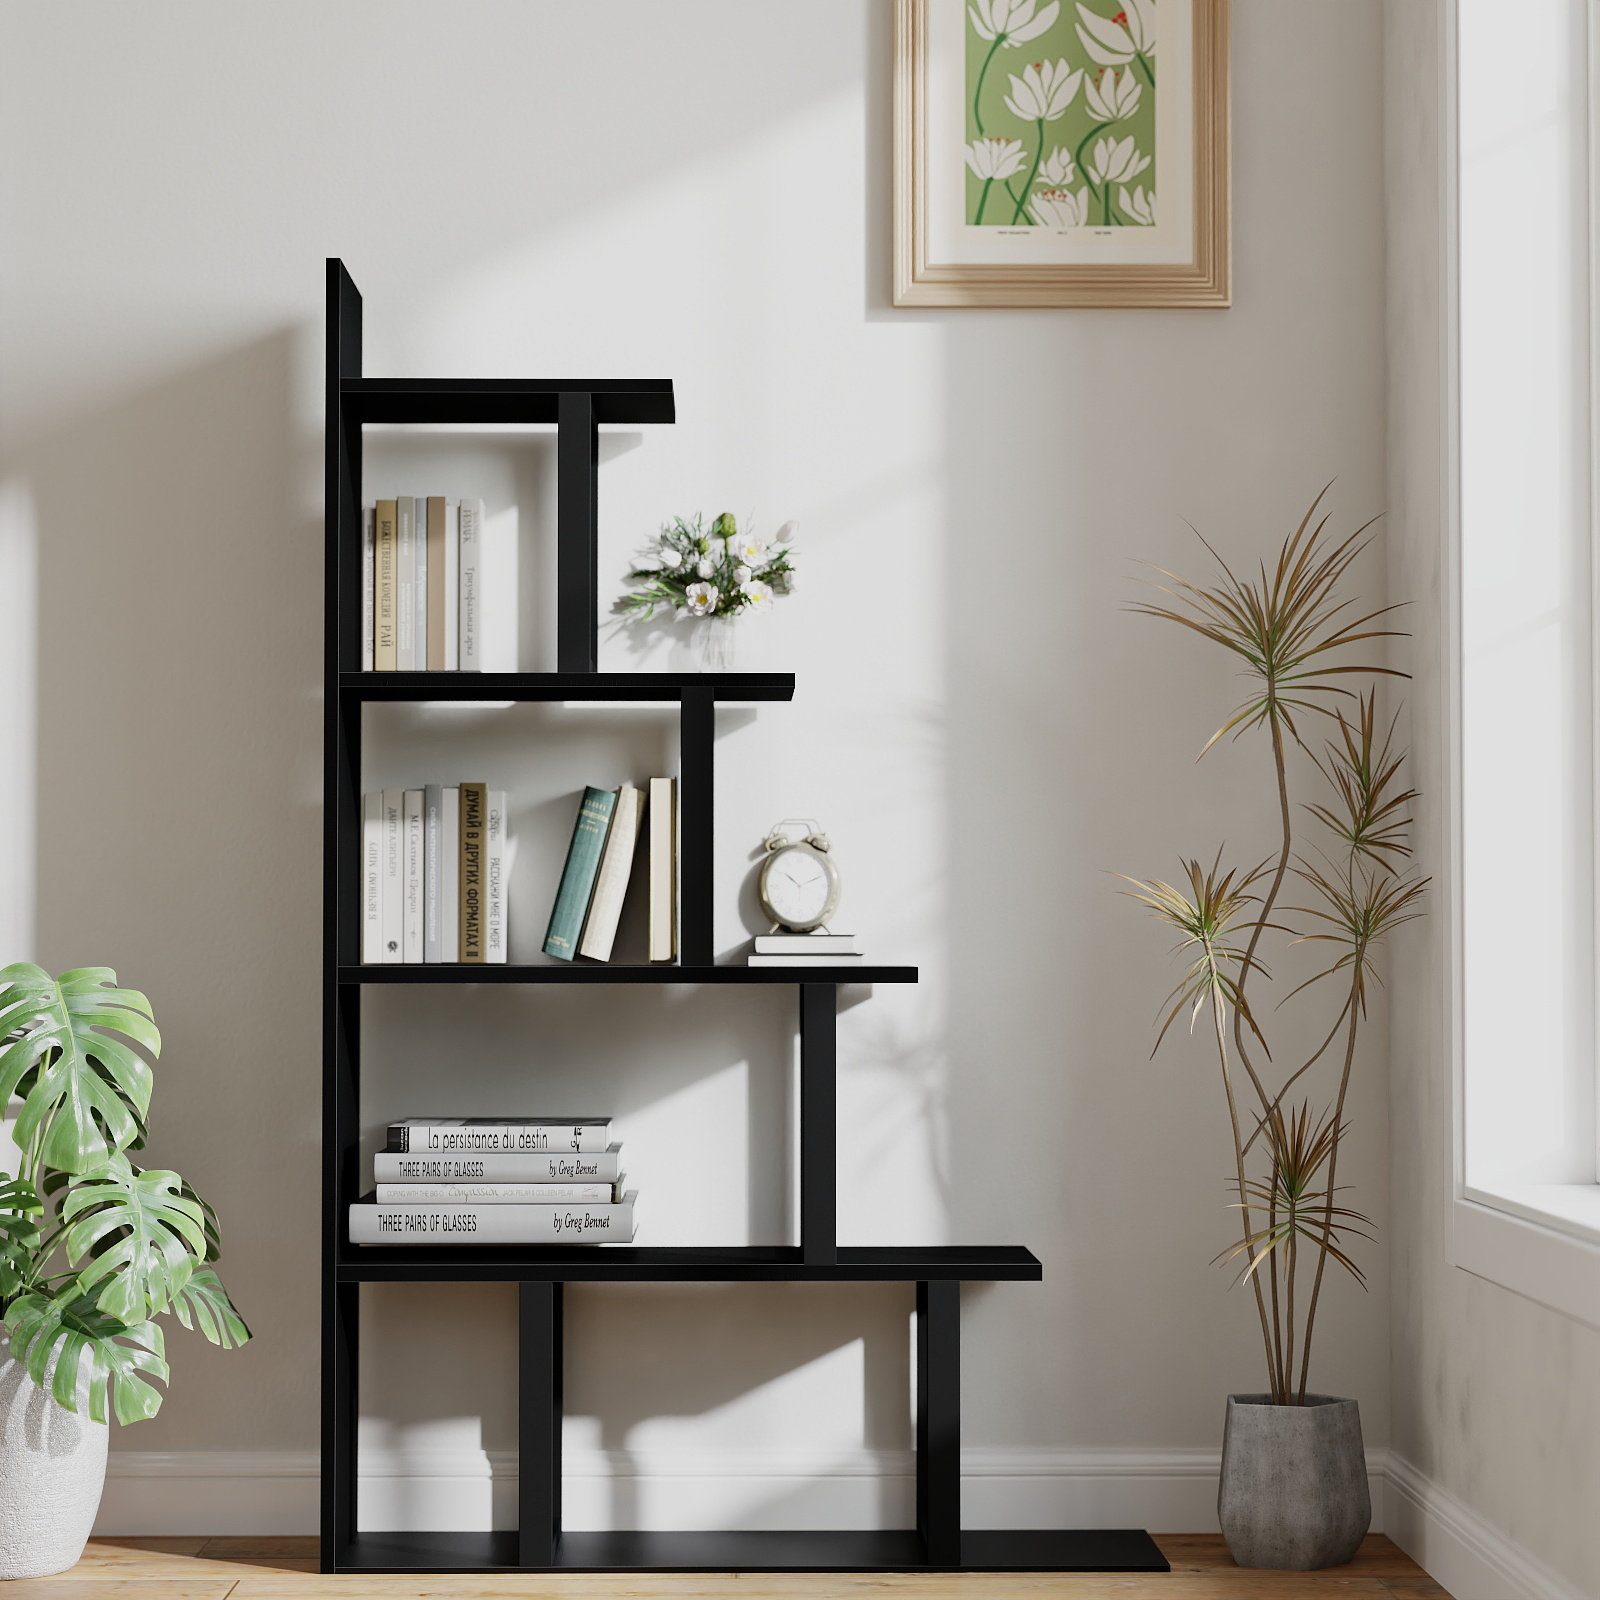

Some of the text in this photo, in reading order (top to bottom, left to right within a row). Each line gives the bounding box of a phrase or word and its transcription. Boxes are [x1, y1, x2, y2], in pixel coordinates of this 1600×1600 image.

[463, 509, 472, 544] РЕМАРК
[381, 521, 394, 647] БОЖЕСТВЕННАЯ КОМЕДИЯ РАЙ
[464, 566, 476, 656] Триумфальная арка
[465, 789, 482, 828] ДУМАЙ
[368, 842, 377, 868] МИРУ
[388, 807, 396, 877] ДАНТЕ АЛИГЬЕРИ
[465, 842, 478, 885] ДРУГИХ
[490, 857, 501, 899] РАССКАЖИ
[368, 872, 377, 912] ВЕЧНОМУ
[466, 889, 479, 947] ФОРМАТАХ
[490, 901, 501, 919] МНЕ
[490, 928, 501, 950] МОРЕ
[428, 1127, 439, 1149] La
[443, 1128, 499, 1153] persistance
[502, 1126, 515, 1149] du
[519, 1126, 548, 1149] destin
[398, 1161, 484, 1177] THREE PAIRS OF GLASSES
[549, 1160, 598, 1178] by Greg Bennet
[378, 1214, 477, 1232] THREE PAIRS OF GLASSES
[553, 1212, 610, 1233] by Greg Bennet
